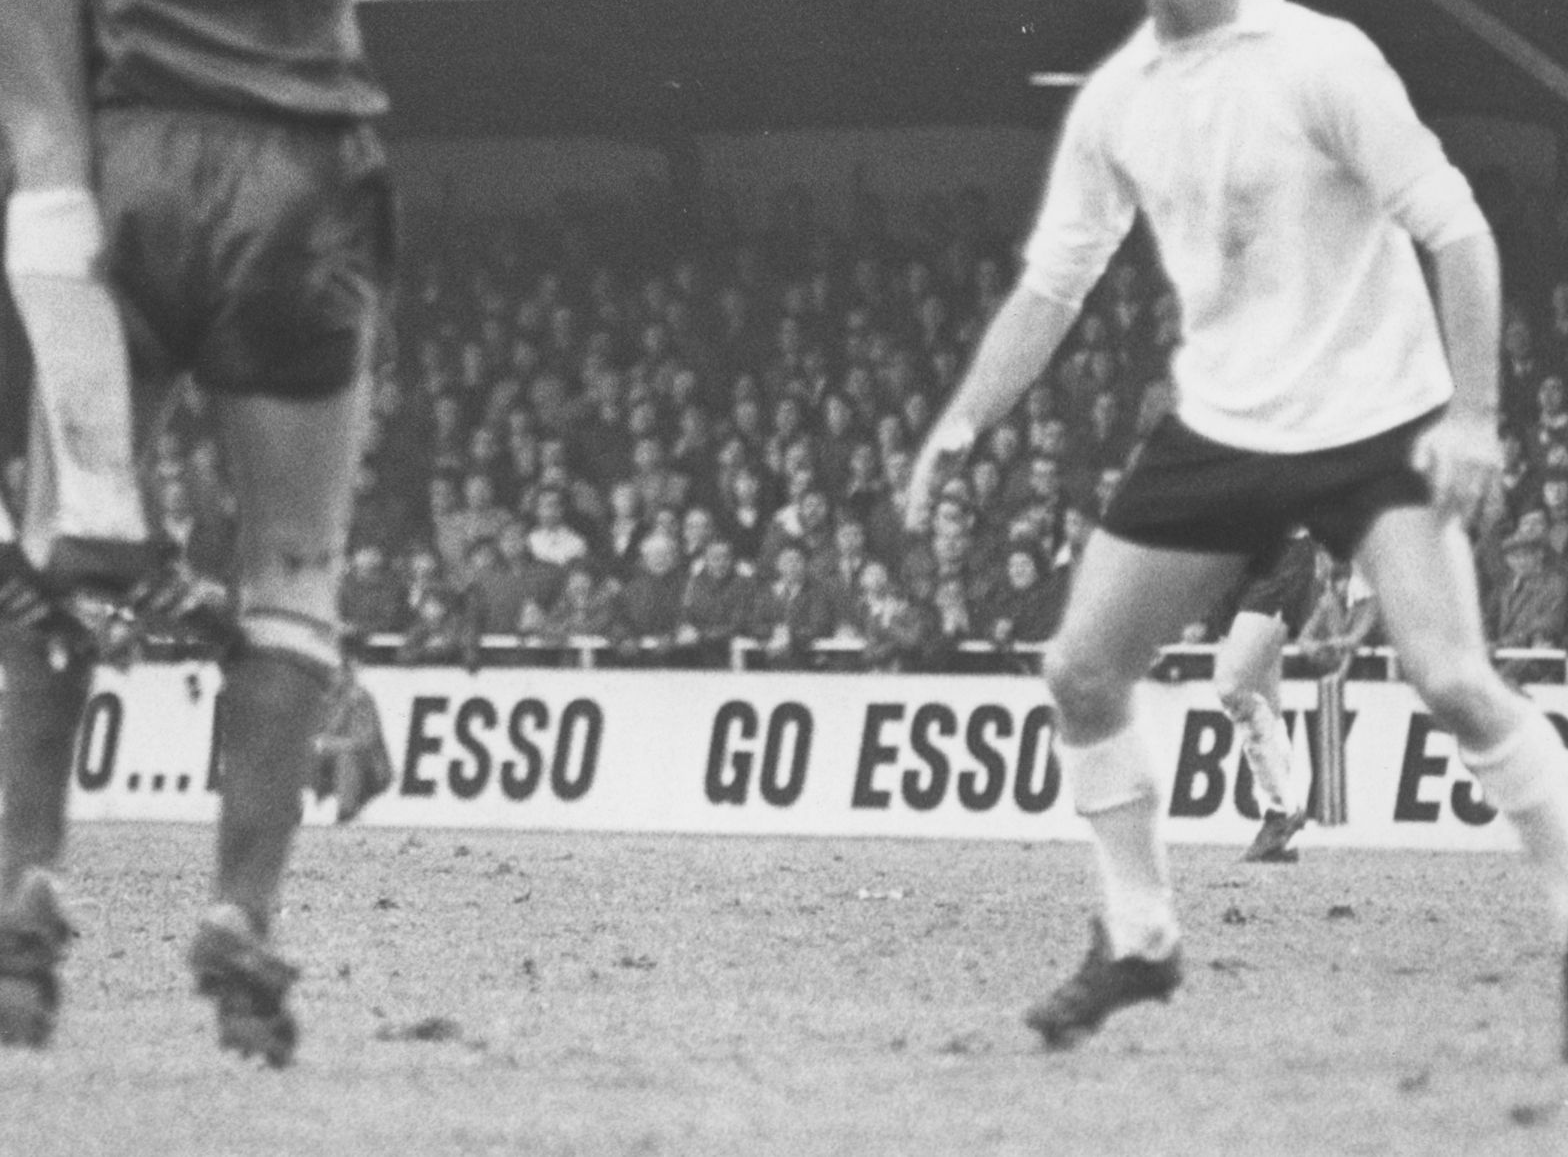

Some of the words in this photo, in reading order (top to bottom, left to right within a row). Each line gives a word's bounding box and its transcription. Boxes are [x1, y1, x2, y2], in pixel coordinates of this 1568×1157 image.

[399, 696, 605, 802] ESSO
[704, 699, 814, 808] GO
[851, 702, 1062, 815] ESSO
